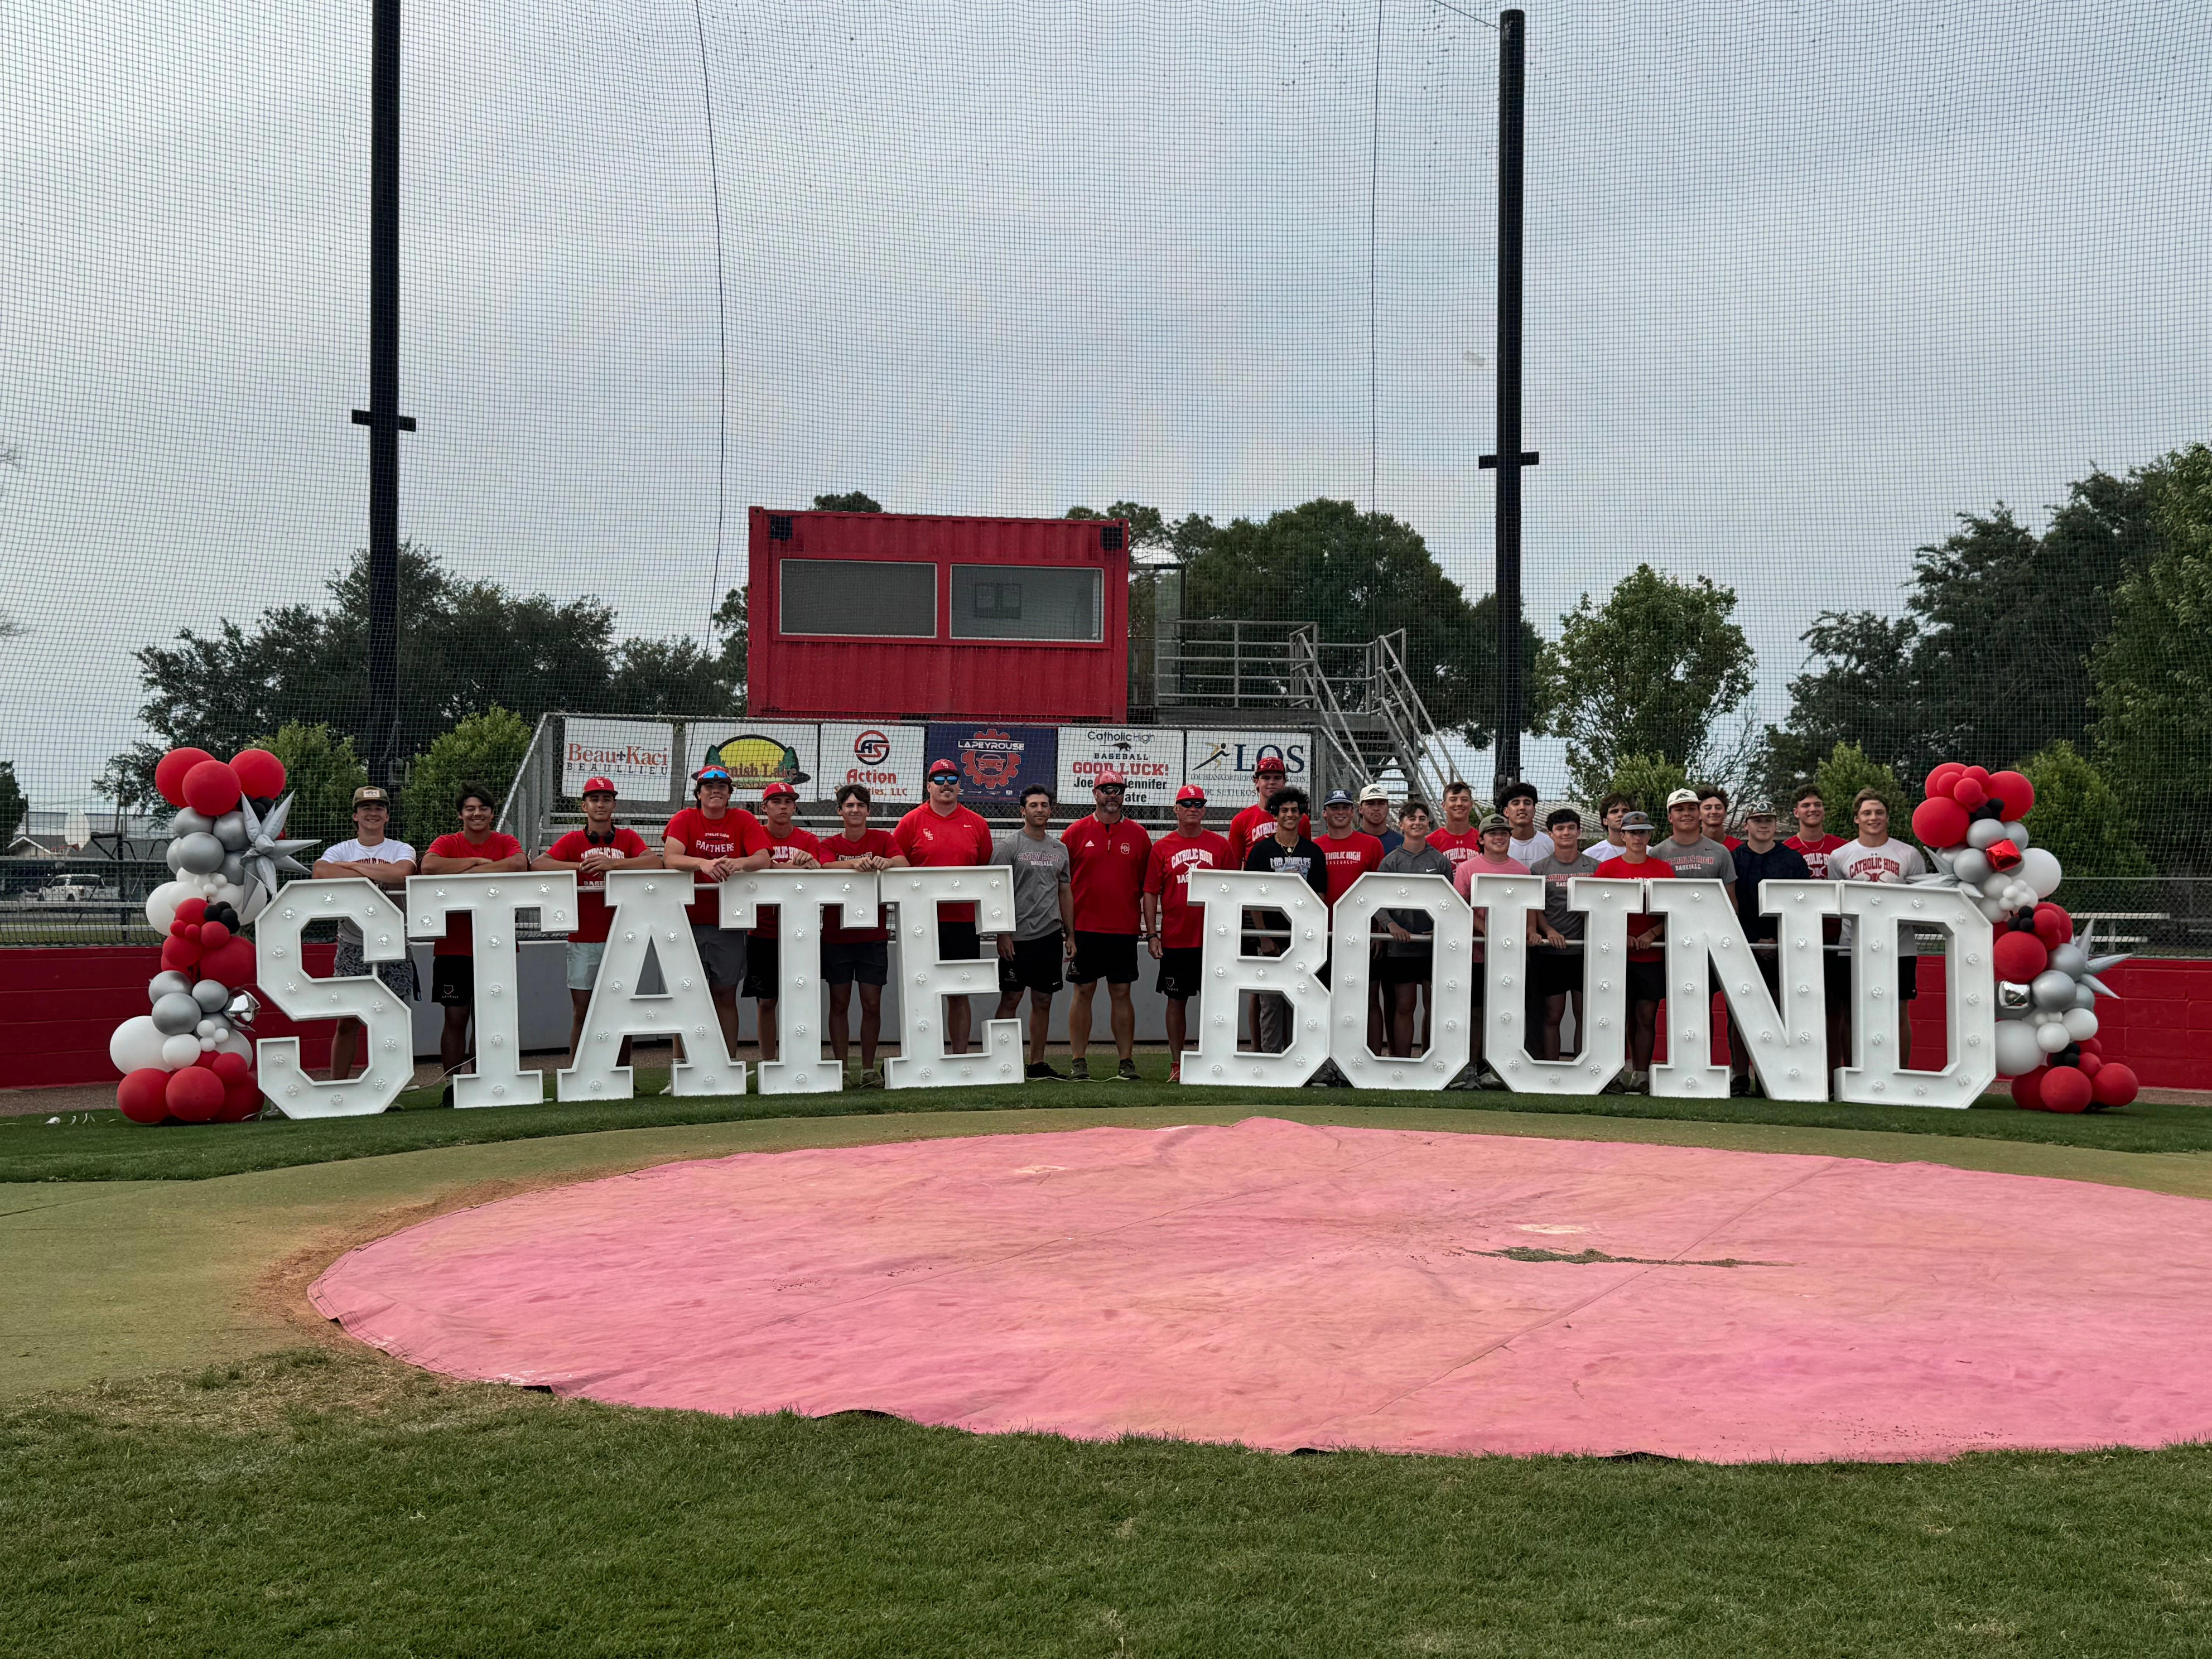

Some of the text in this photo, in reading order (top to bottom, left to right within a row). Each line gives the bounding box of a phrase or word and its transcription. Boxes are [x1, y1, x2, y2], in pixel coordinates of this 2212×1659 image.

[957, 740, 1025, 751] LAPEYROUSE
[568, 742, 668, 766] Beau Kaci
[566, 762, 668, 775] BEAULLIEU
[762, 763, 797, 780] Lake
[846, 768, 897, 784] Action
[1072, 761, 1169, 776] GOOD LUCK!
[1073, 777, 1093, 788] Joe
[696, 840, 735, 853] PANTHERS
[1171, 848, 1213, 869] CATHOLIC HIGH
[1346, 851, 1361, 861] HIGH
[1675, 863, 1702, 871] BASEBALL
[1849, 857, 1900, 879] CATHOLIC HIGH
[256, 864, 1996, 1120] STATE BOUND
